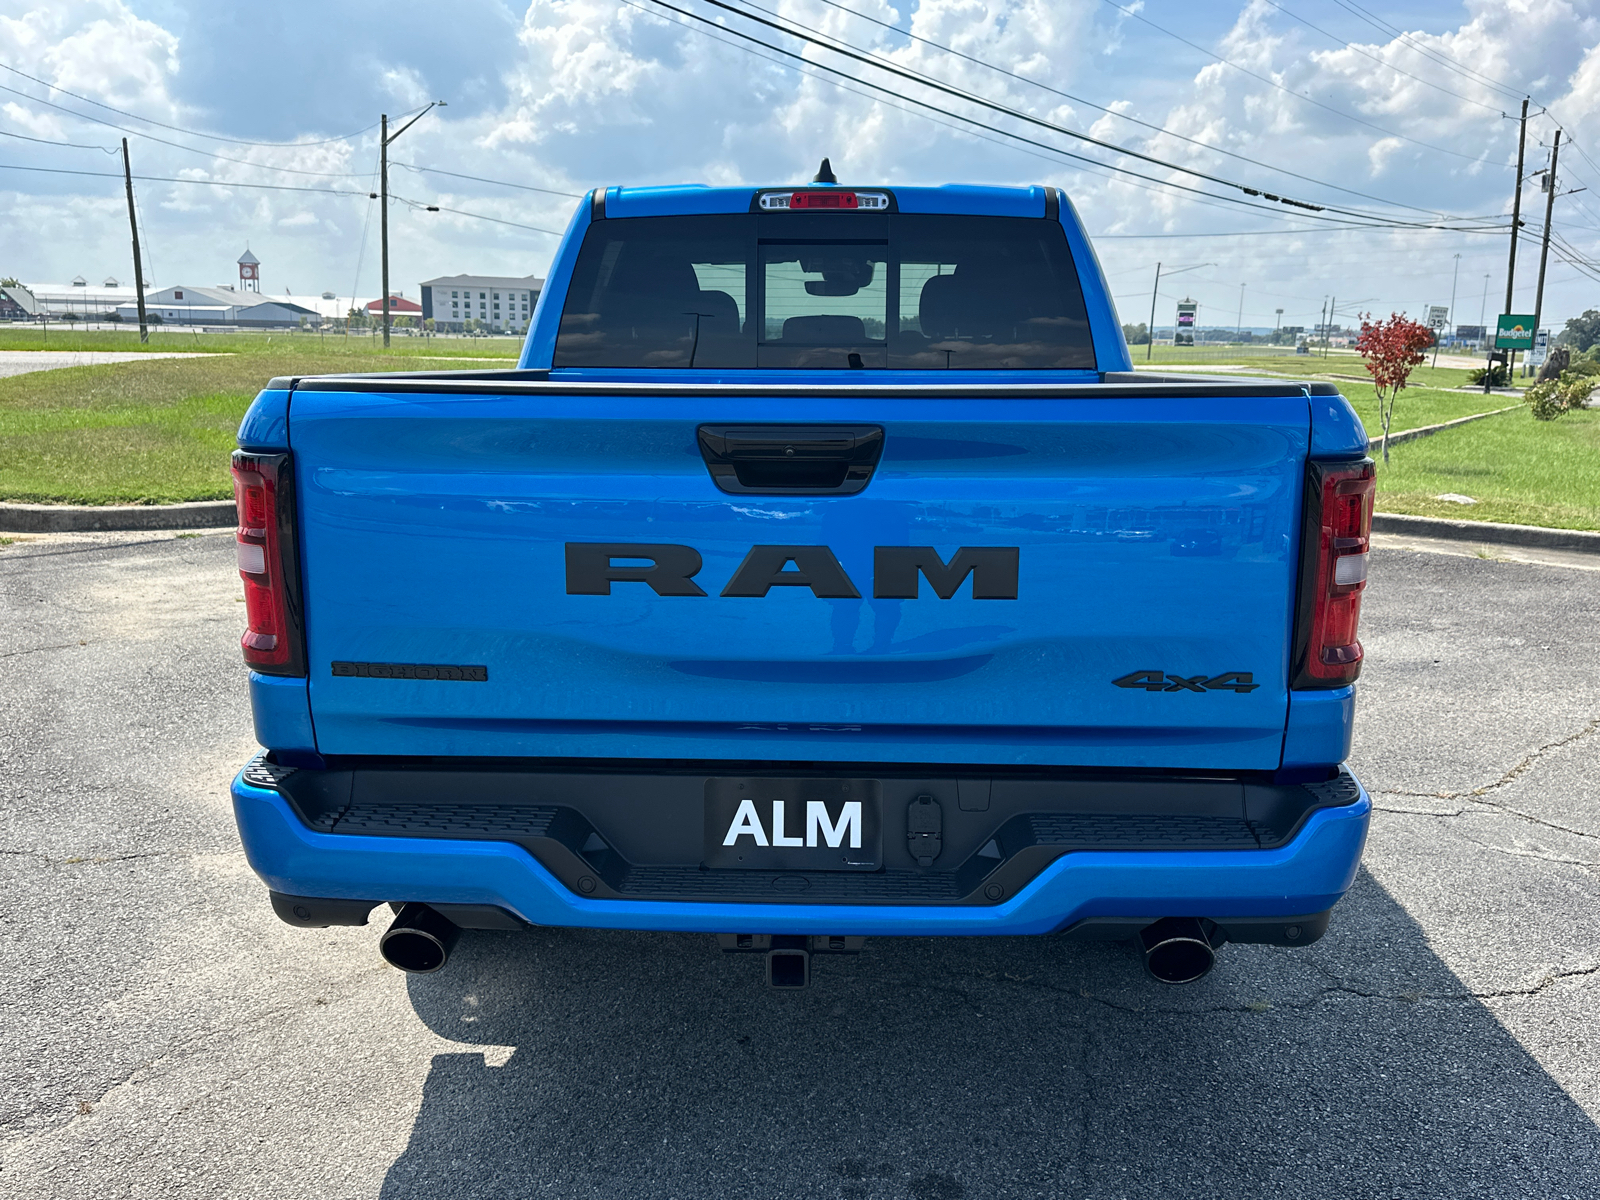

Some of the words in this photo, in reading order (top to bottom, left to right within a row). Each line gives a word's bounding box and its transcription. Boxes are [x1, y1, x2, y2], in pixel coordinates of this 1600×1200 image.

[1429, 319, 1443, 328] 35
[1499, 328, 1532, 339] Budgetel
[565, 542, 1020, 599] RAM
[331, 661, 488, 682] BIGHORN
[1111, 670, 1261, 693] 4x4
[722, 799, 862, 849] ALM
